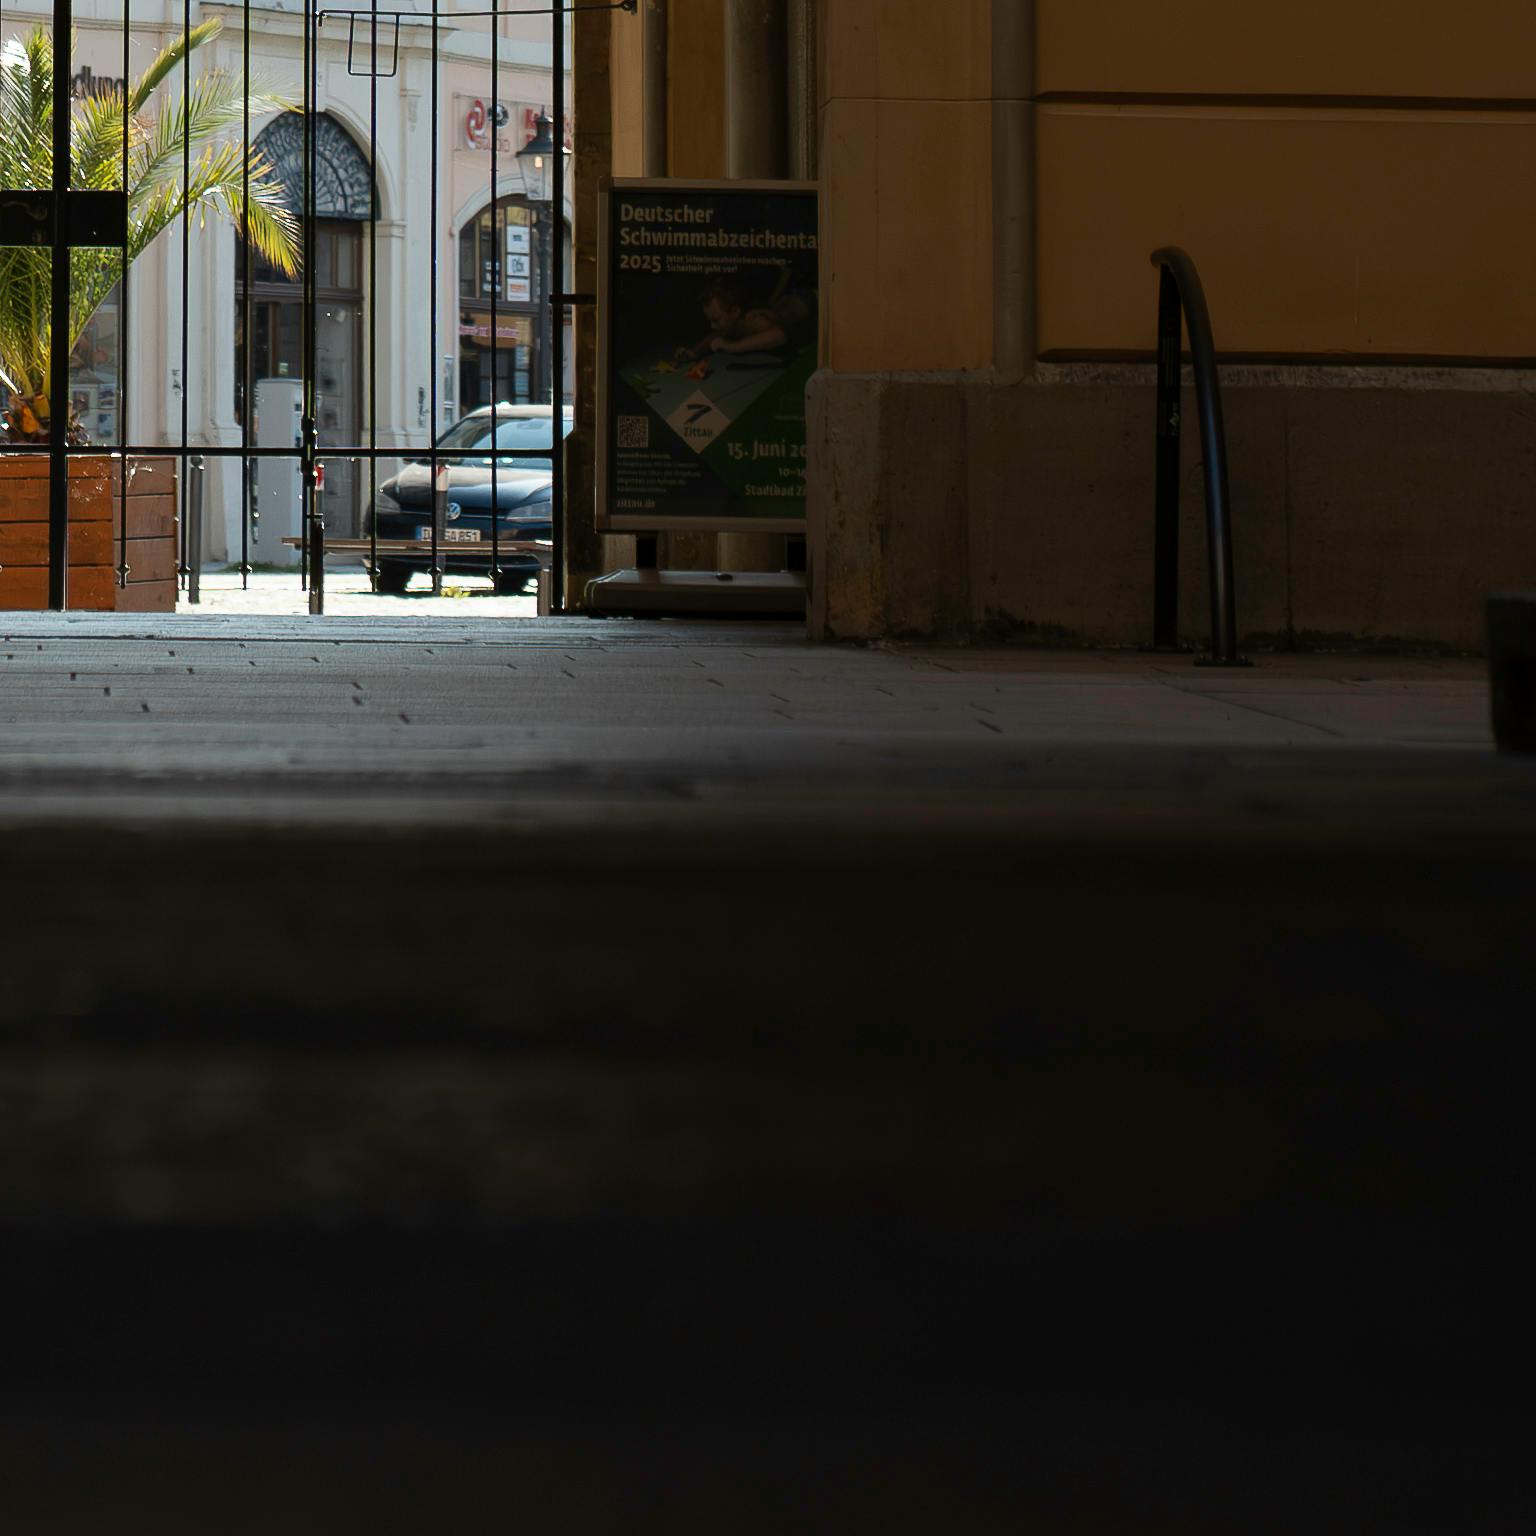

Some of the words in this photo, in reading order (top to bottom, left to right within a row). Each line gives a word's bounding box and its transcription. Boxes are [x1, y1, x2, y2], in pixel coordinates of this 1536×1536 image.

[620, 203, 714, 223] Deutscher
[620, 255, 661, 273] 2025
[683, 427, 713, 438] Zittau
[727, 442, 749, 460] 15.
[751, 439, 786, 461] Juni
